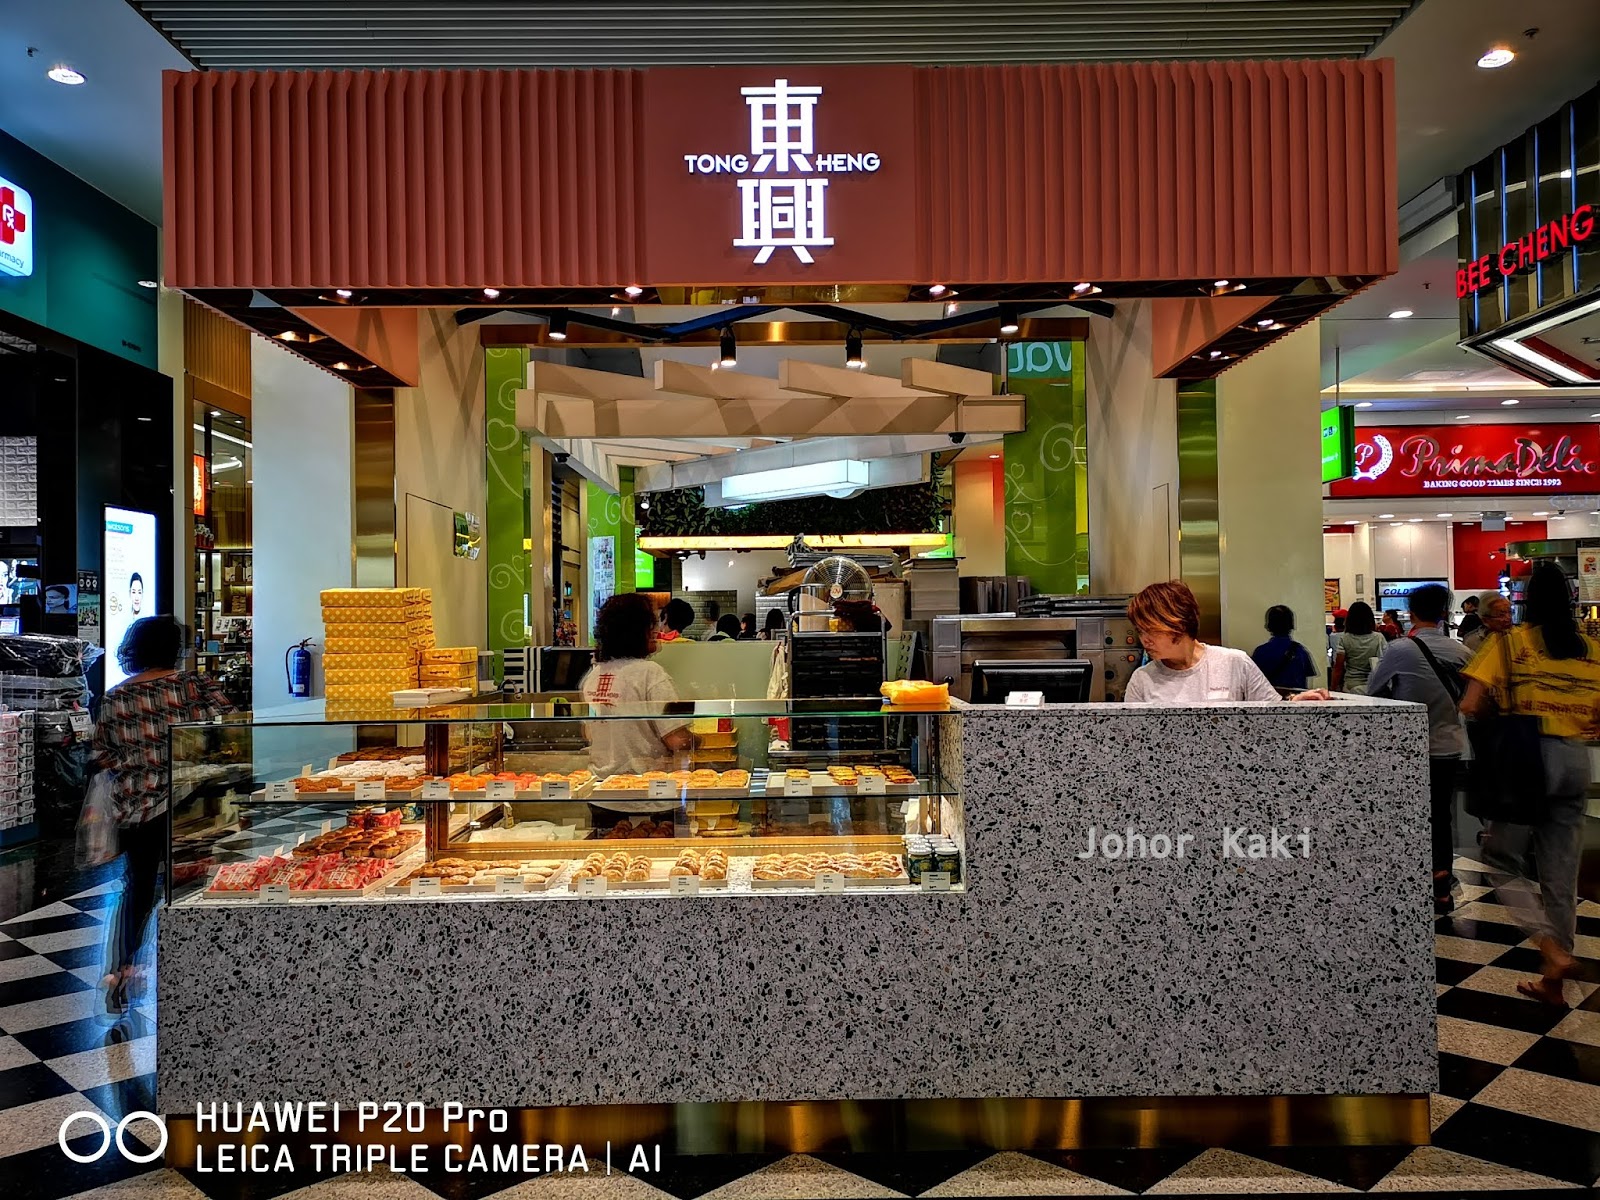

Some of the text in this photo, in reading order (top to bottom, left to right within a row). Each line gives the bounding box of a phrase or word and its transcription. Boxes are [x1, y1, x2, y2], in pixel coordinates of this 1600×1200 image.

[684, 153, 881, 174] TONG HENG
[1456, 204, 1594, 299] BEE CHENG
[1423, 478, 1562, 489] BAKING GOOD TIMES SINCE 1992
